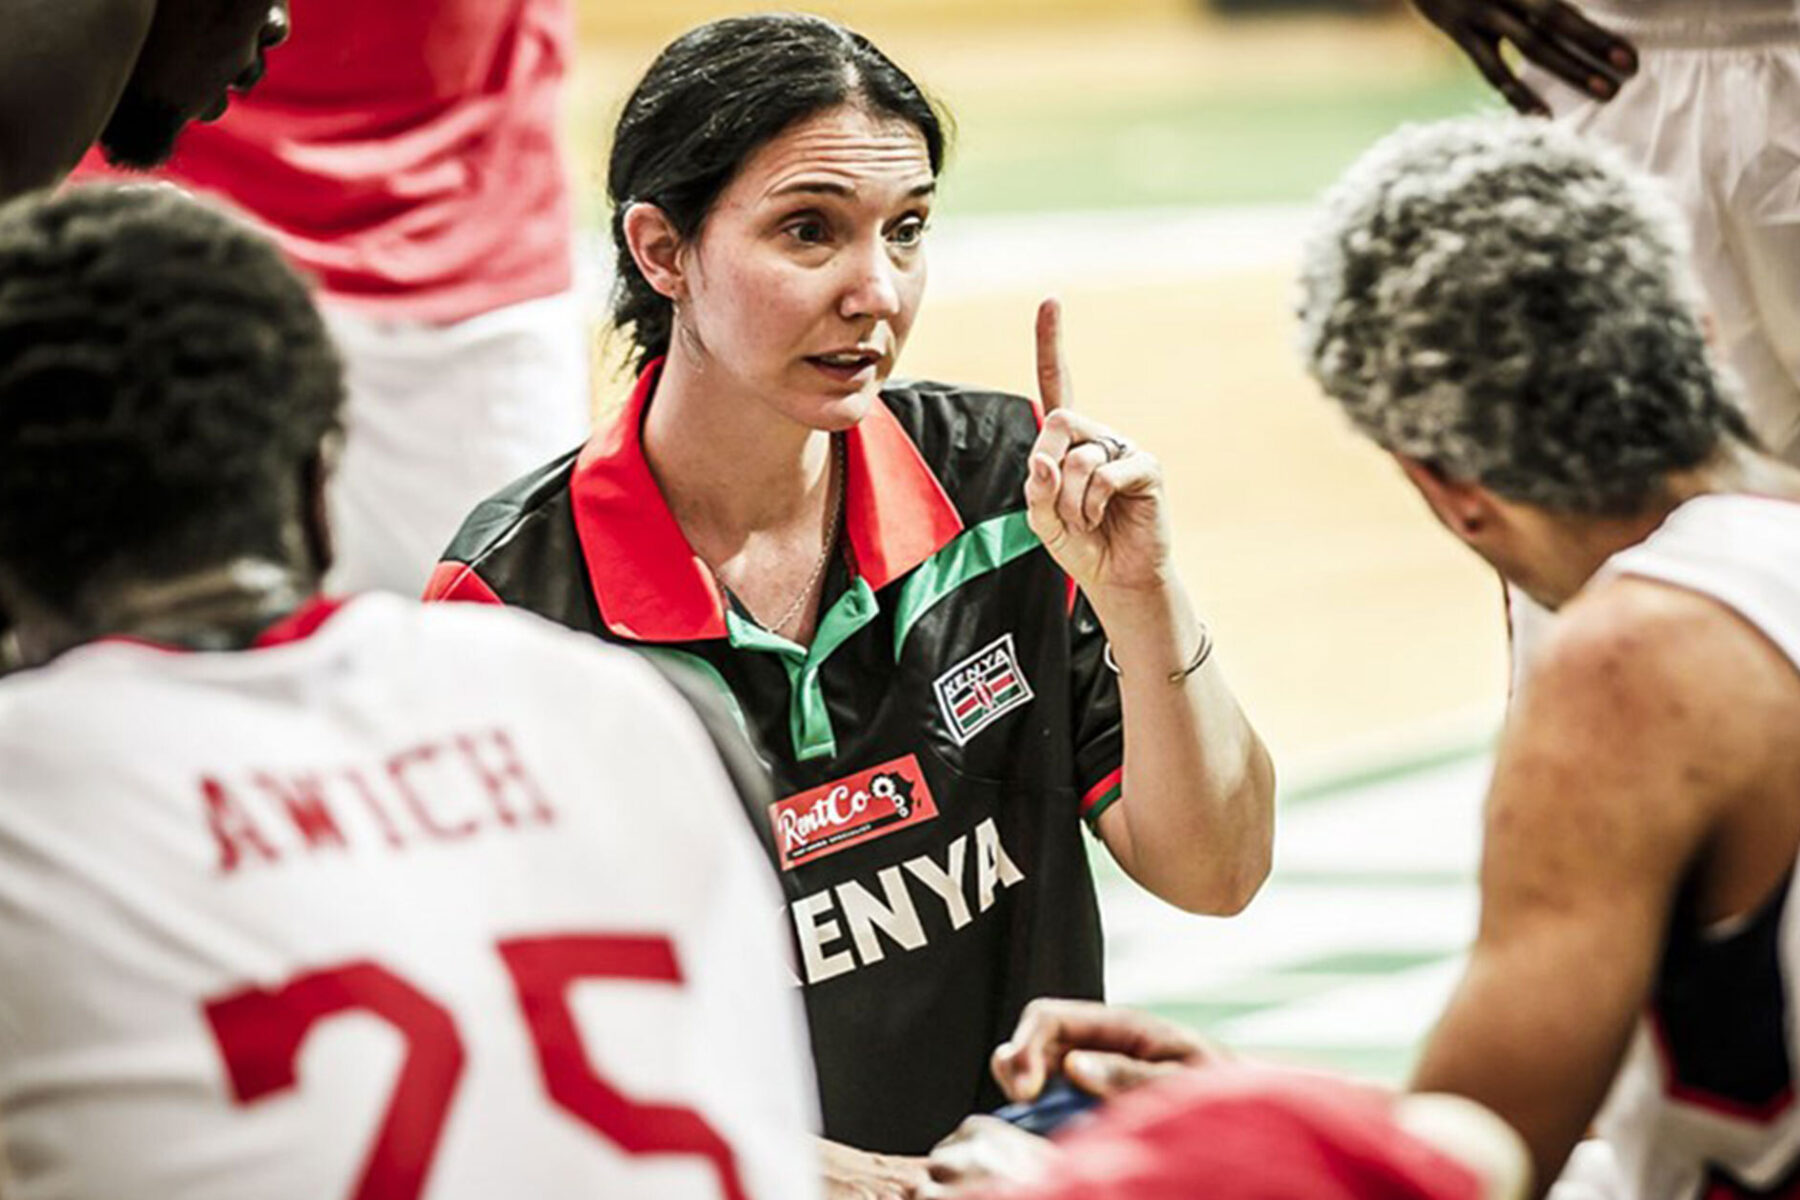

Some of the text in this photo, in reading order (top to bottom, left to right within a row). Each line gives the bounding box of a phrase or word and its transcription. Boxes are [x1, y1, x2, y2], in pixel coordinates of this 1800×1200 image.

[943, 648, 1009, 698] KENYA
[200, 727, 557, 876] AWICH
[777, 785, 871, 851] RentCo
[780, 817, 1025, 985] ENYA
[202, 931, 753, 1200] 25
